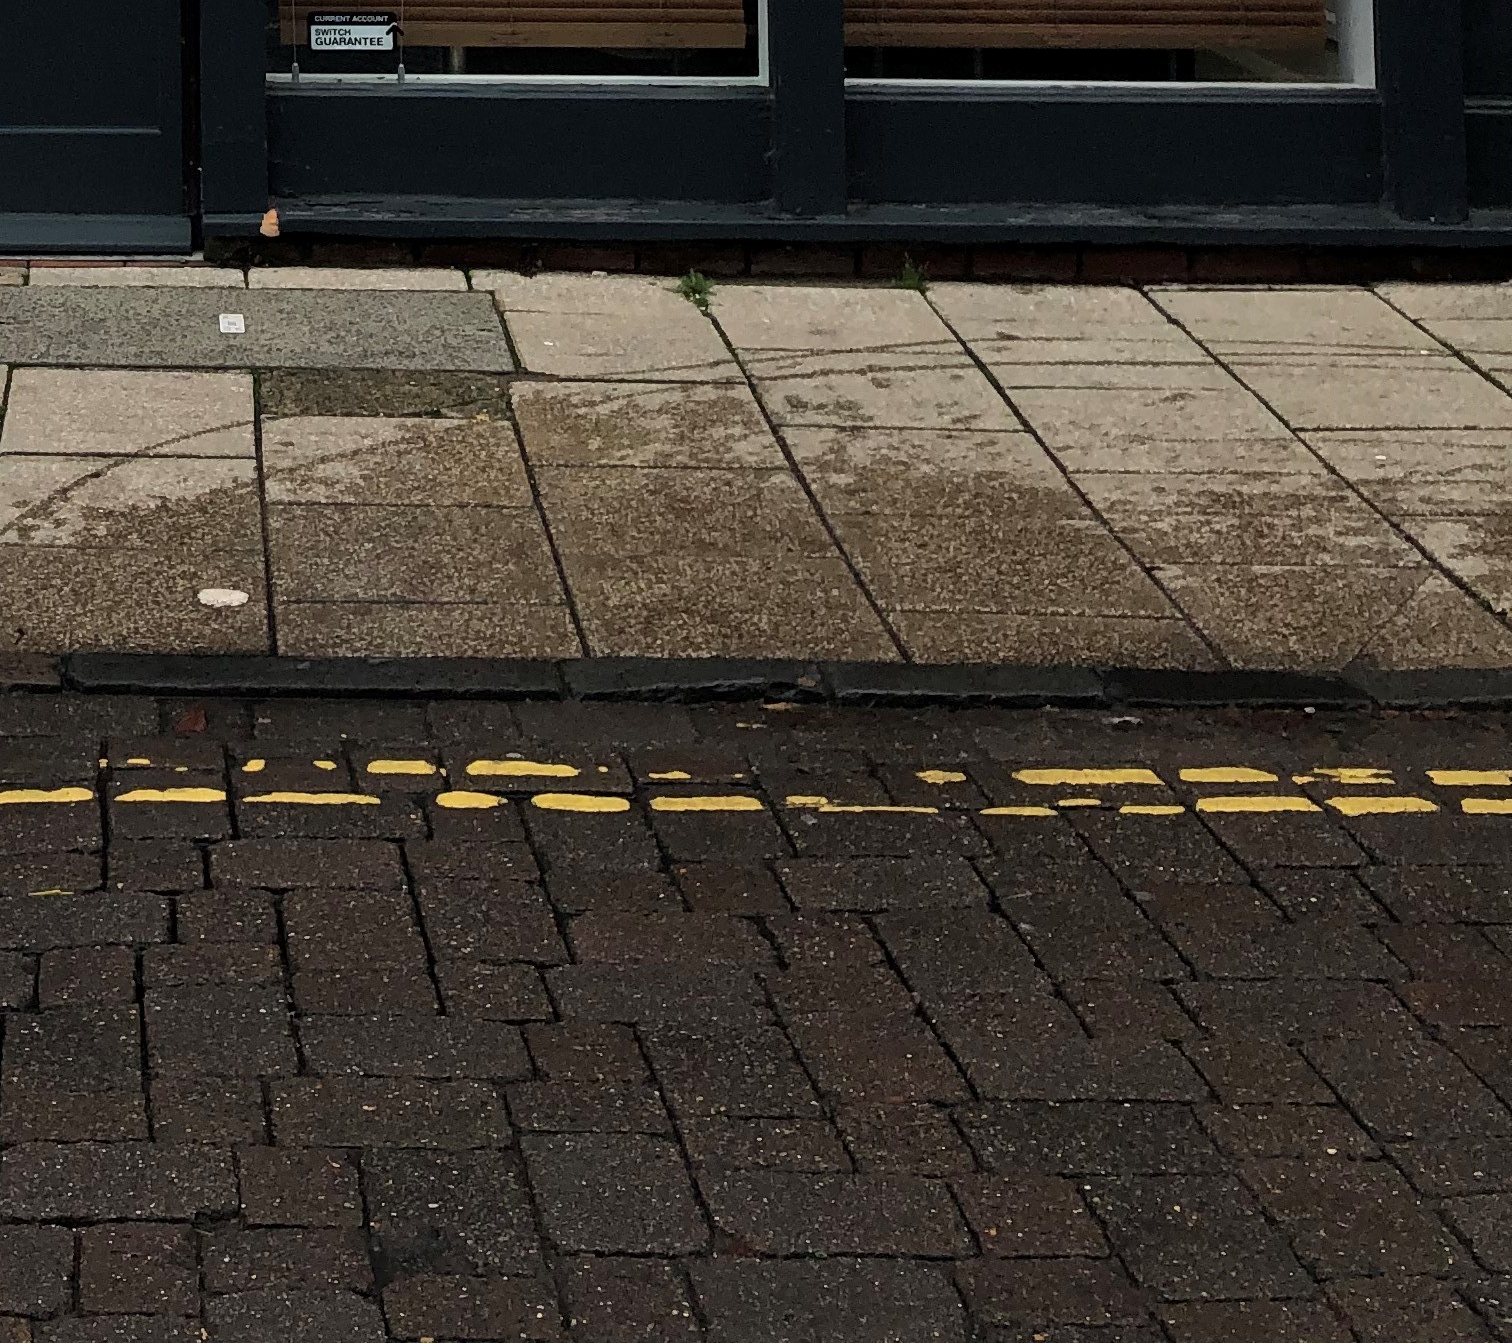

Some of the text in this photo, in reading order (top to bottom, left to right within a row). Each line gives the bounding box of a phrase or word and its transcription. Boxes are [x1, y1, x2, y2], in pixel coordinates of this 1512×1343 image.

[315, 15, 389, 23] CURRENT ACCOUNT
[315, 28, 351, 36] SWITCH
[315, 37, 384, 46] GUARANTEE
